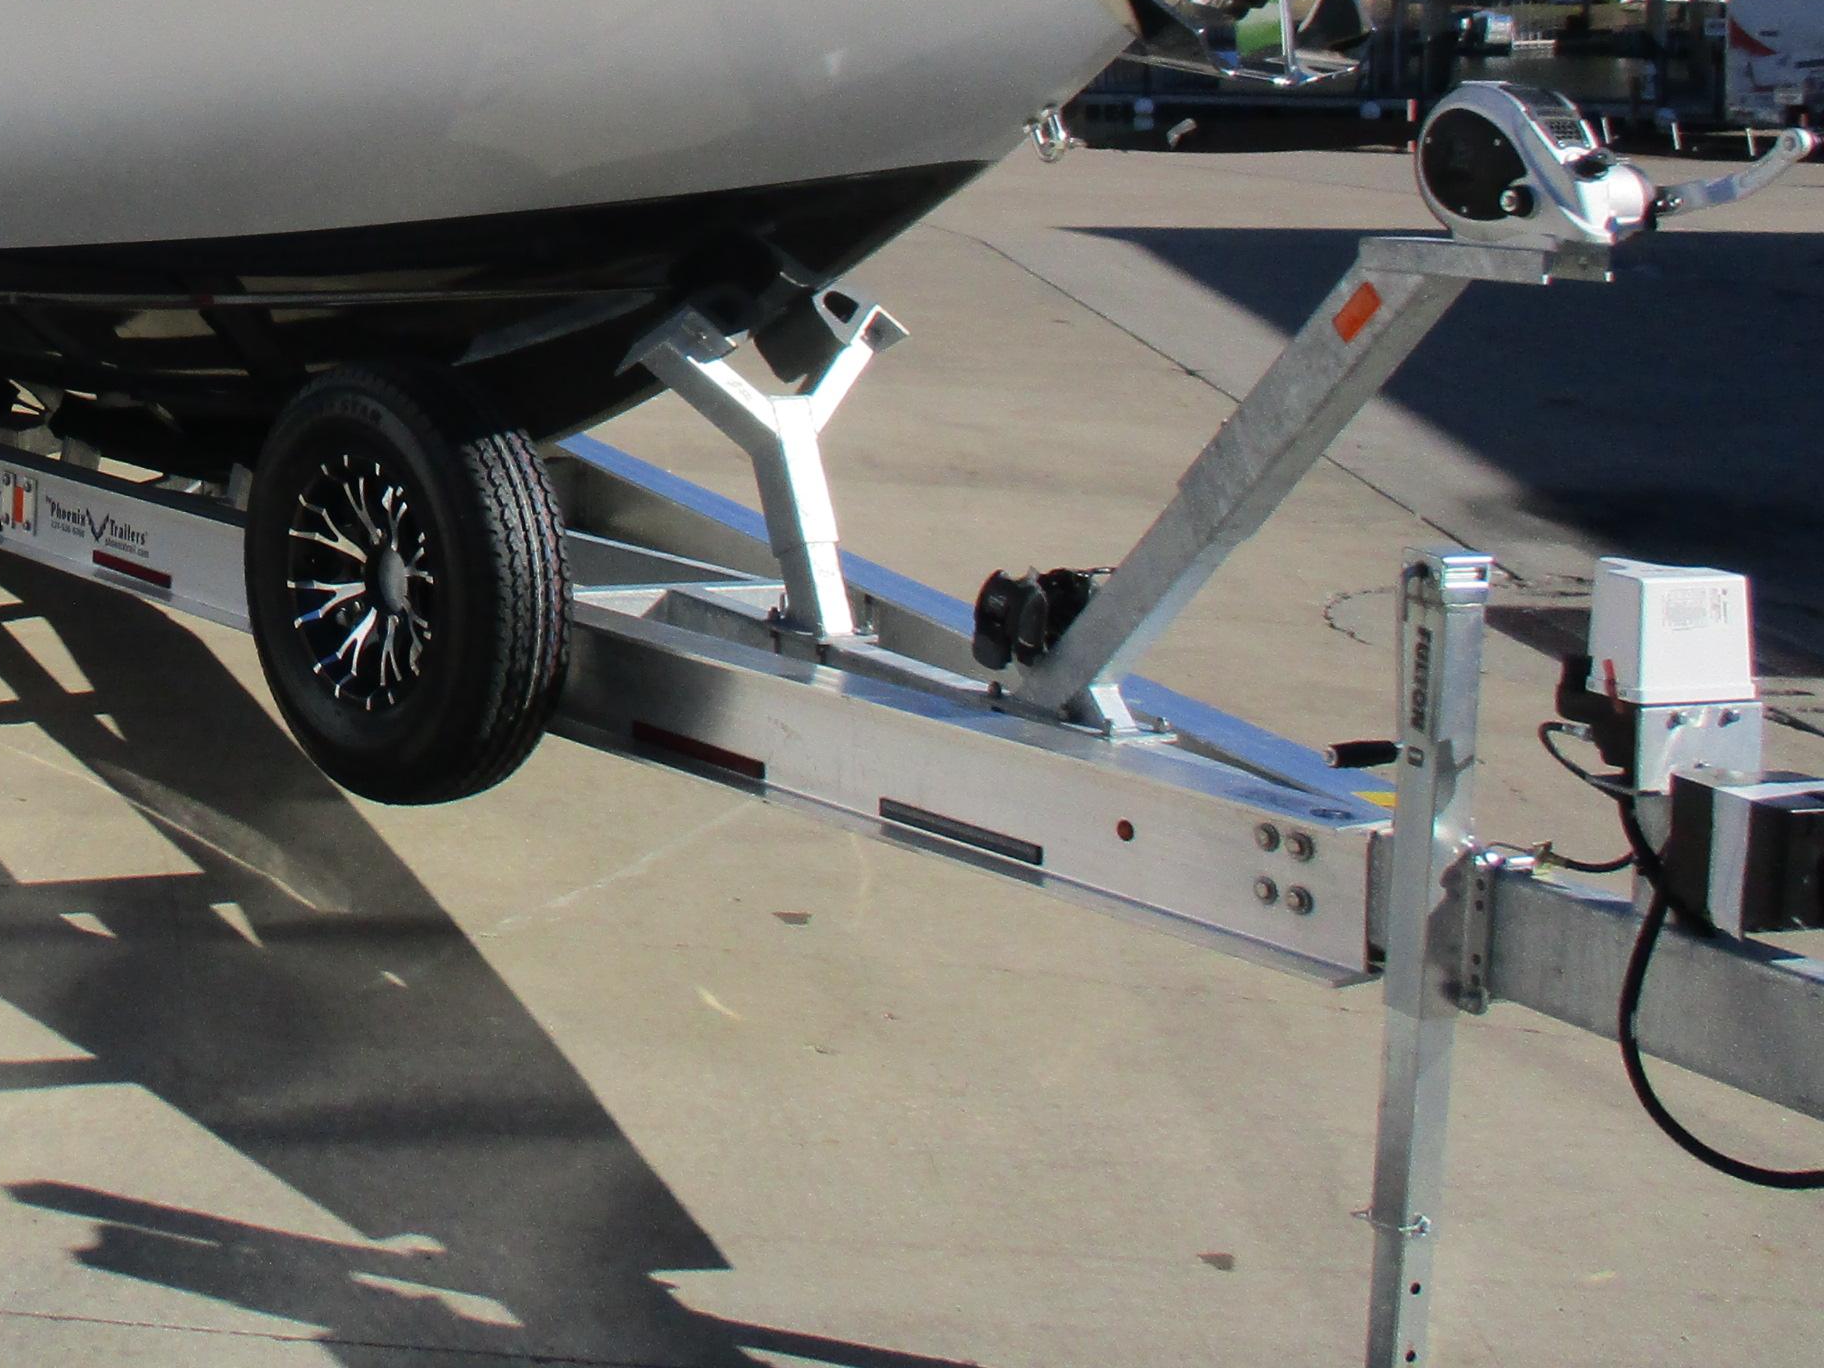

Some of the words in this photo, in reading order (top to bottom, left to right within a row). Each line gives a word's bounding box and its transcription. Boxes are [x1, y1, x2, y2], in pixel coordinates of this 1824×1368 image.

[50, 501, 87, 527] Phoenix
[110, 518, 147, 545] Trailers
[1410, 625, 1433, 734] FULTON
